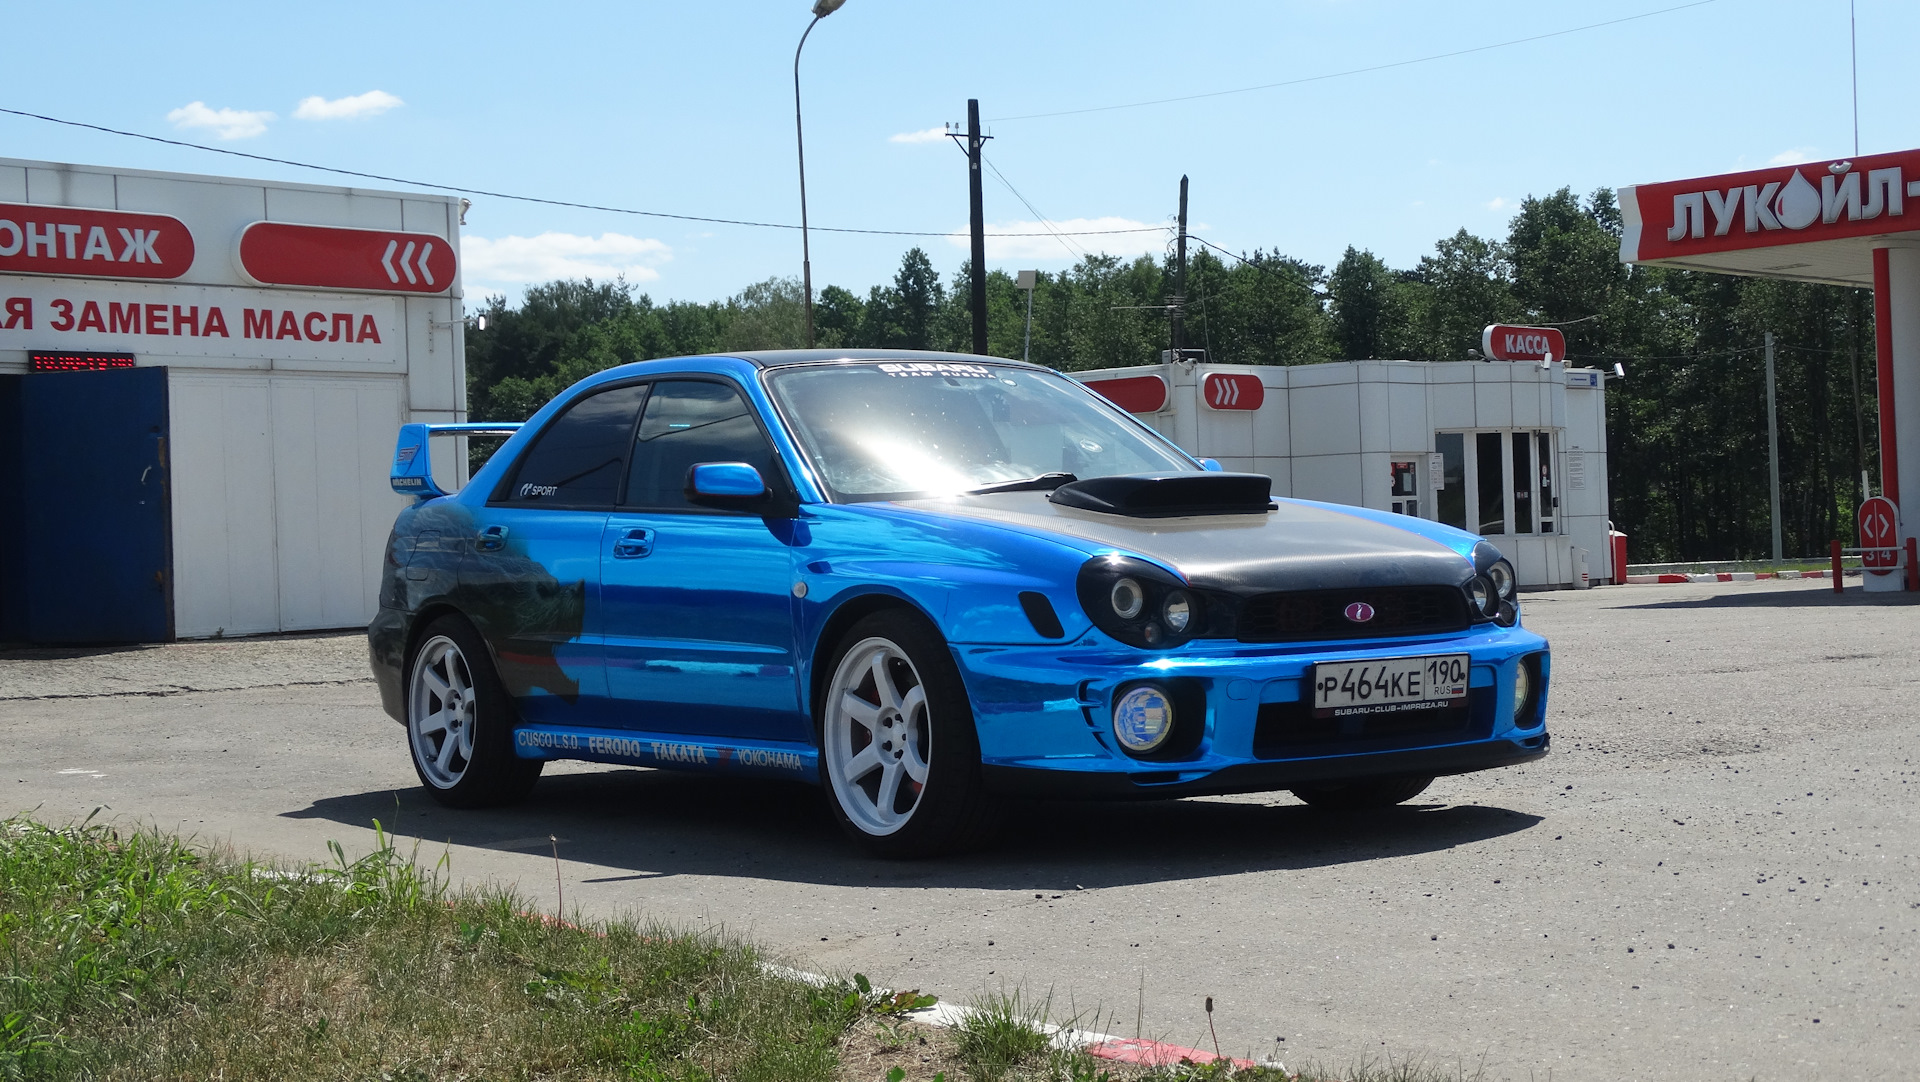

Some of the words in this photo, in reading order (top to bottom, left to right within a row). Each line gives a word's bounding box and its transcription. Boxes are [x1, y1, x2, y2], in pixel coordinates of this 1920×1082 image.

[49, 298, 230, 338] ЗАМЕНА
[243, 308, 382, 344] МАСЛА
[1505, 334, 1551, 354] КАССА
[878, 363, 989, 374] SUBARU
[392, 478, 422, 486] MICHELIN
[531, 485, 558, 496] SPORT
[1881, 550, 1892, 561] 4
[1428, 659, 1461, 685] 190
[1434, 685, 1451, 695] RUS
[1334, 700, 1449, 716] SUBARU-CLUB-IMPREZA.RU
[518, 731, 552, 748] CUSCO
[588, 736, 641, 758] FERODO
[651, 742, 708, 765] TAKATA
[736, 748, 804, 771] YOKOHAMA
